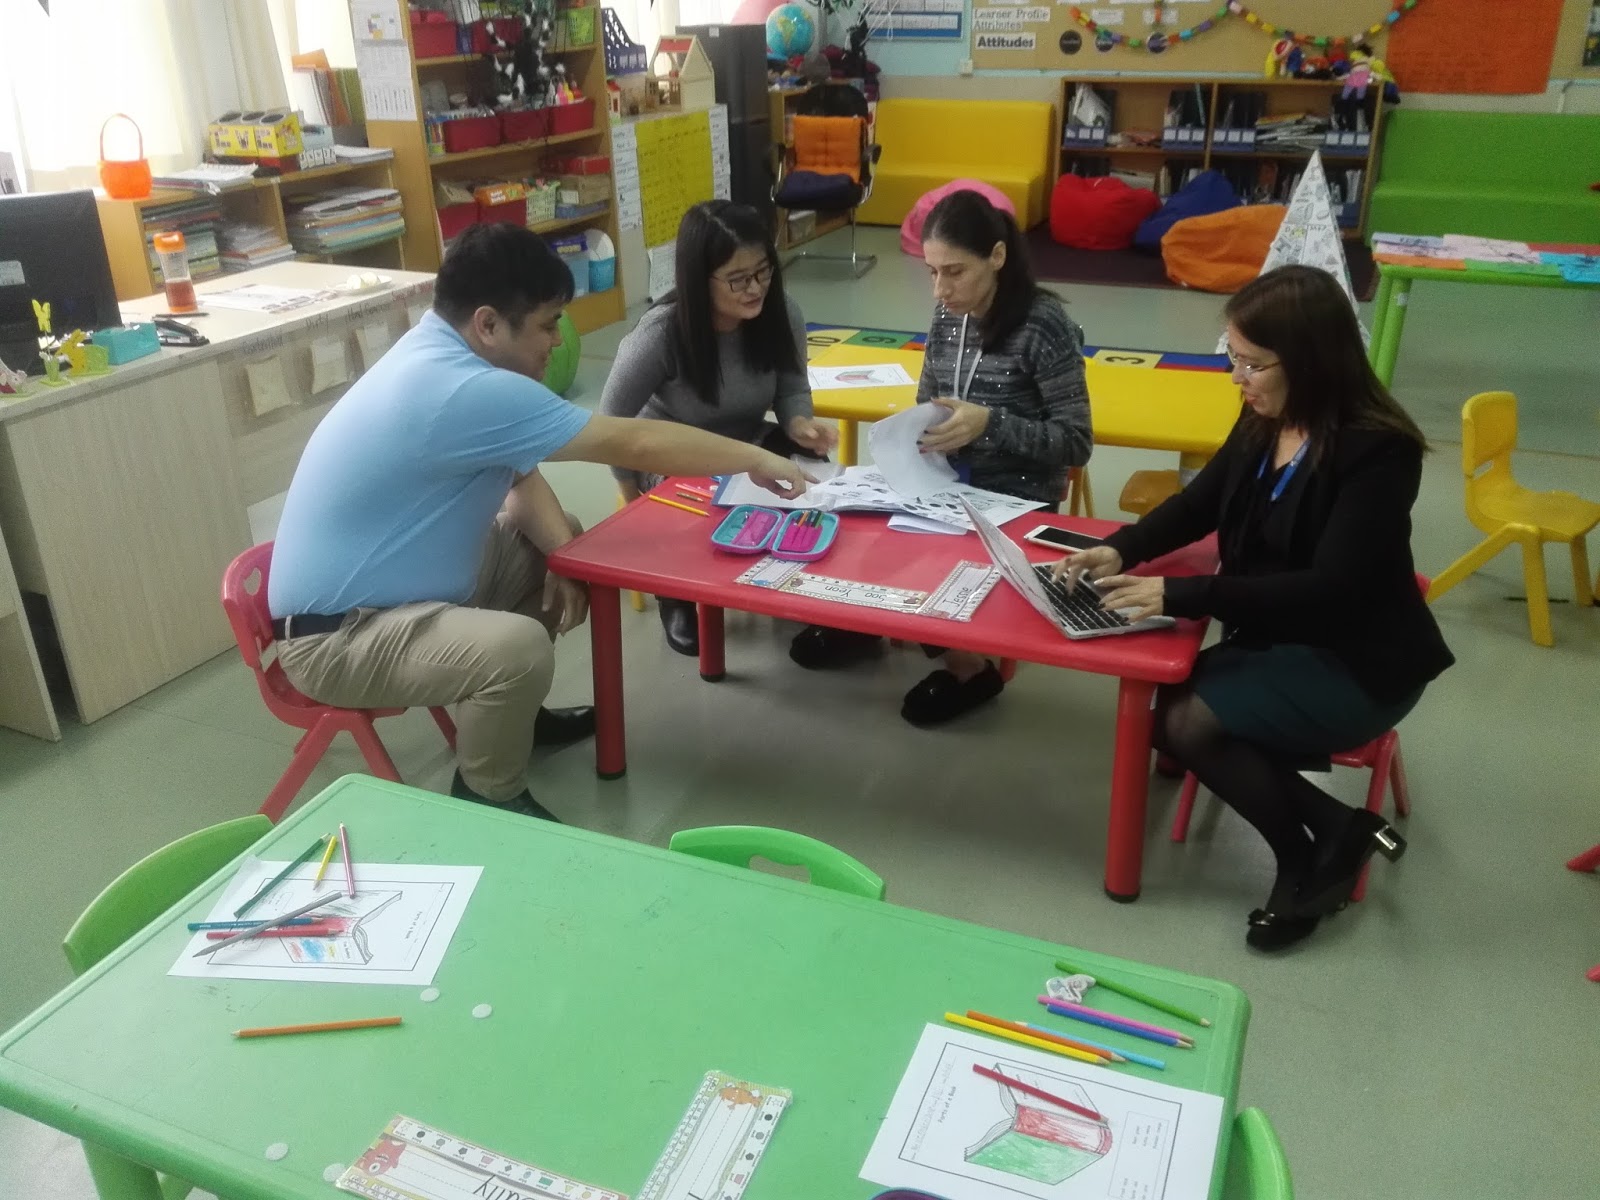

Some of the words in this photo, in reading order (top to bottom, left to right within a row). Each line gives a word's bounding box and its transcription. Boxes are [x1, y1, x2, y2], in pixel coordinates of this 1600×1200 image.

[974, 9, 1012, 19] Learner
[1016, 9, 1049, 20] Profile
[978, 36, 1034, 48] Attitudes
[824, 585, 852, 598] Yeon
